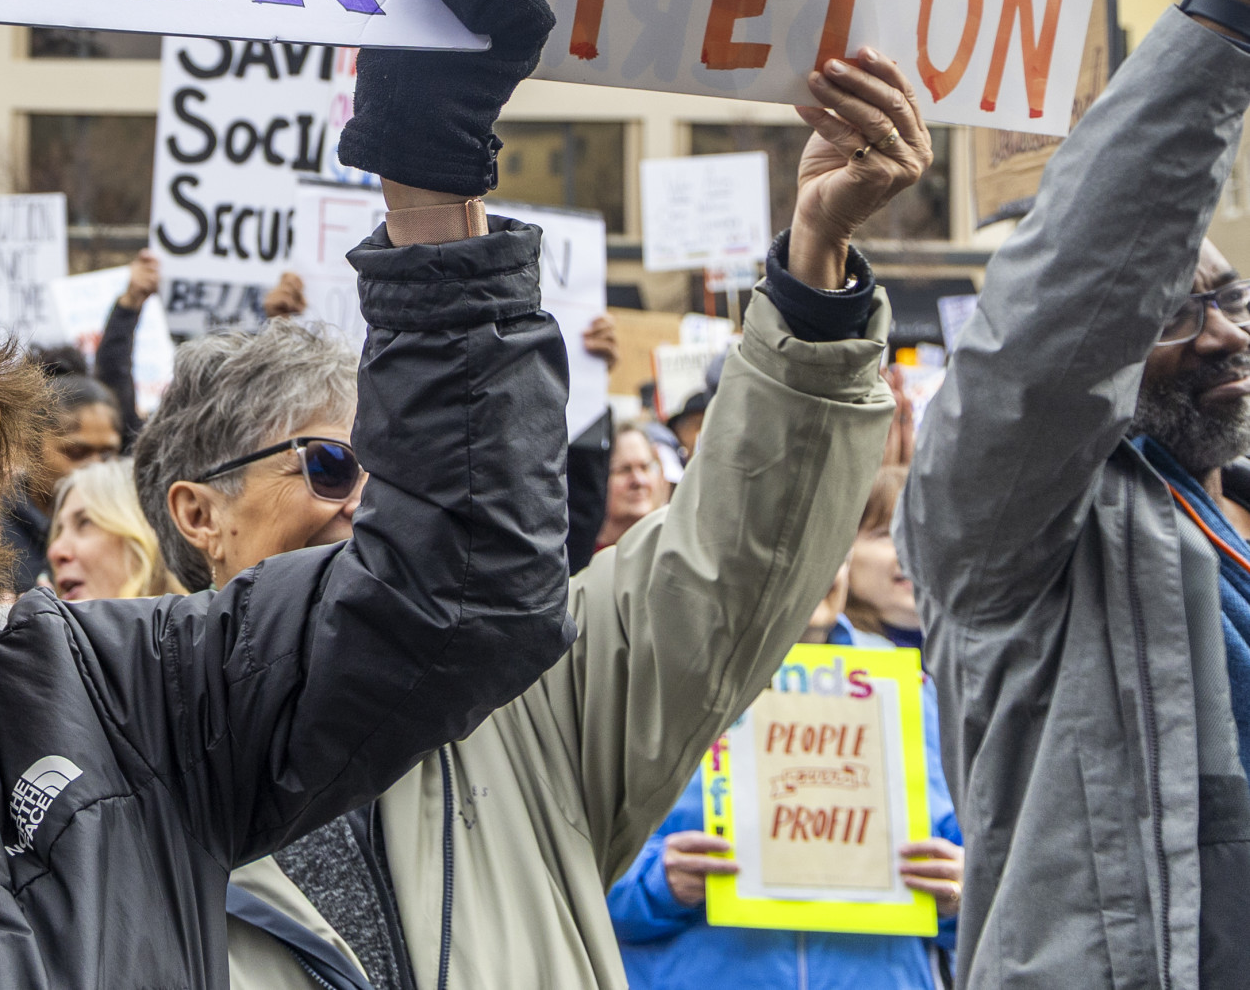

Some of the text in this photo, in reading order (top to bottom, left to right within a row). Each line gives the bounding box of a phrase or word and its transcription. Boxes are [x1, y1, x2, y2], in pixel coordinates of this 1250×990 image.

[765, 720, 869, 757] PEOPLE
[4, 783, 41, 857] NORTH
[10, 778, 28, 821] THE
[24, 792, 54, 851] FACE
[770, 804, 878, 846] PROFIT
